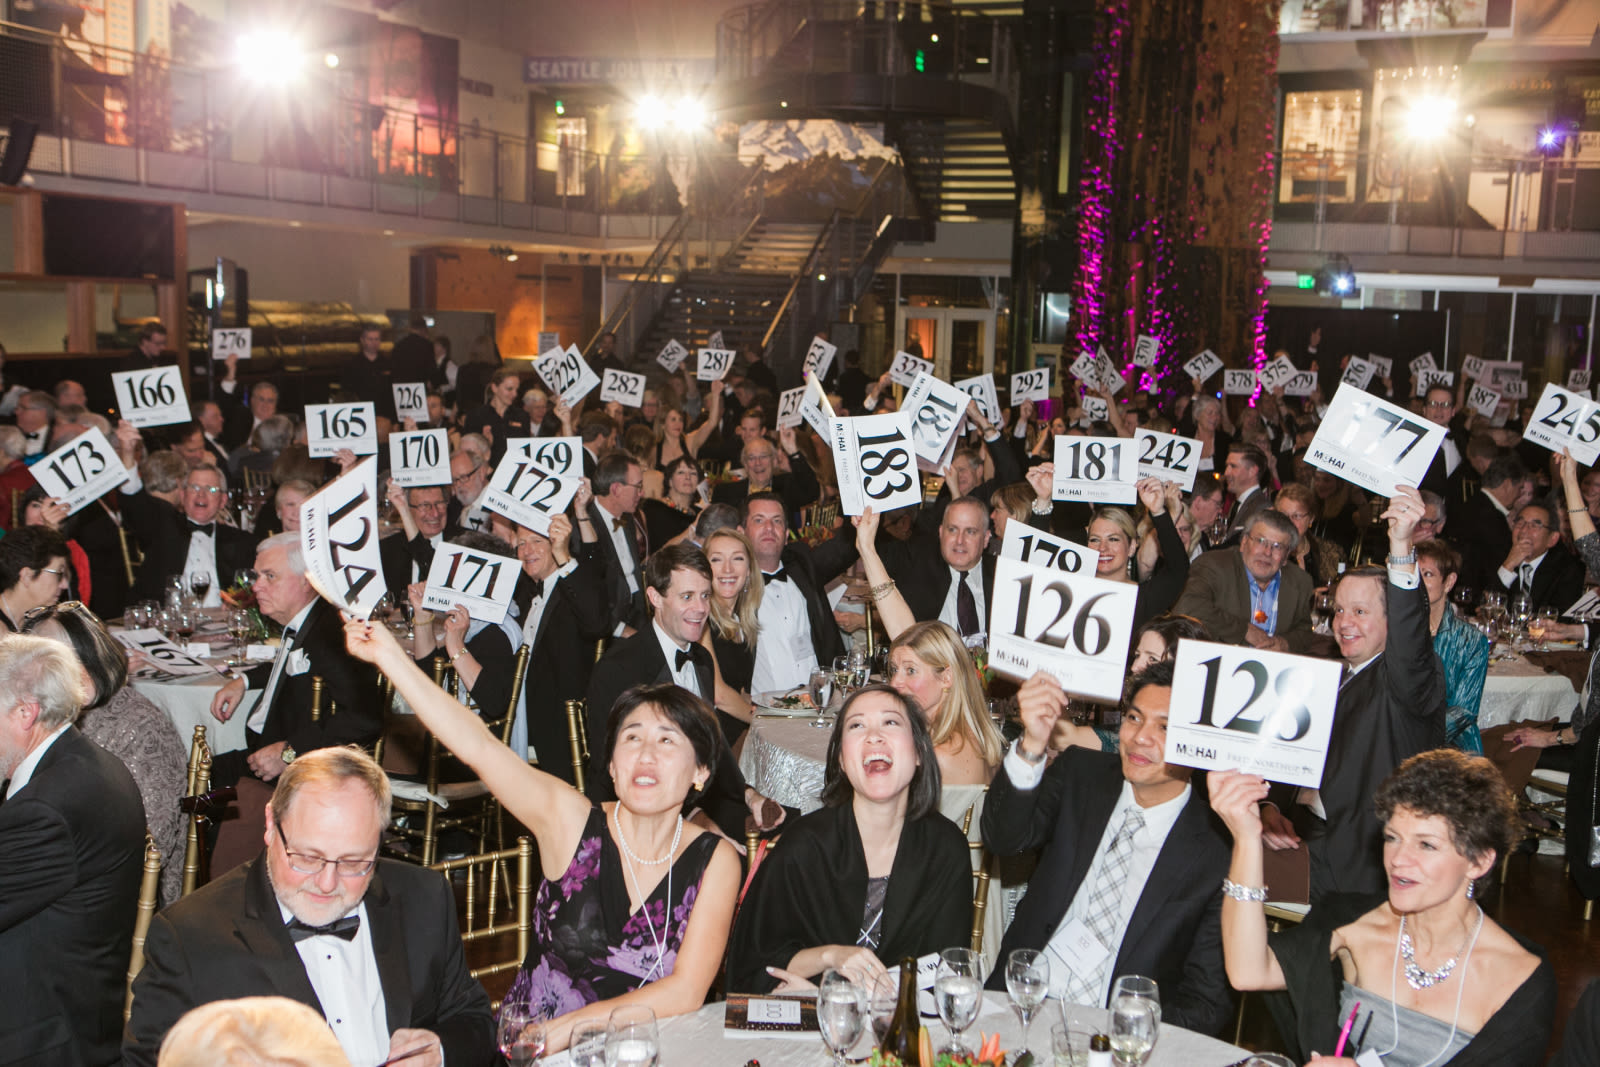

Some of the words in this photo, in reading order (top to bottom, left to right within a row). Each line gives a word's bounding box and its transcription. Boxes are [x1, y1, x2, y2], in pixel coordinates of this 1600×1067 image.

[528, 61, 600, 79] SEATTLE
[605, 62, 686, 80] JOUEY
[218, 331, 246, 351] 276
[807, 343, 825, 373] 323
[555, 353, 581, 395] 229
[704, 351, 730, 371] 281
[1189, 353, 1214, 376] 374
[1262, 360, 1289, 385] 375
[1343, 362, 1366, 387] 376
[123, 371, 176, 409] 166
[607, 372, 640, 397] 282
[1015, 371, 1044, 394] 292
[1228, 371, 1253, 388] 378
[398, 385, 423, 410] 226
[1471, 386, 1497, 408] 387
[318, 407, 368, 440] 165
[1341, 402, 1431, 465] 177
[1538, 393, 1600, 443] 245
[48, 440, 107, 491] 173
[399, 433, 440, 469] 170
[857, 425, 913, 500] 183
[1067, 441, 1122, 482] 181
[1138, 434, 1192, 473] 242
[504, 462, 562, 513] 172
[327, 481, 378, 606] 124
[441, 551, 502, 600] 171
[1011, 573, 1119, 657] 126
[135, 638, 204, 667] 167
[1189, 655, 1315, 743] 128
